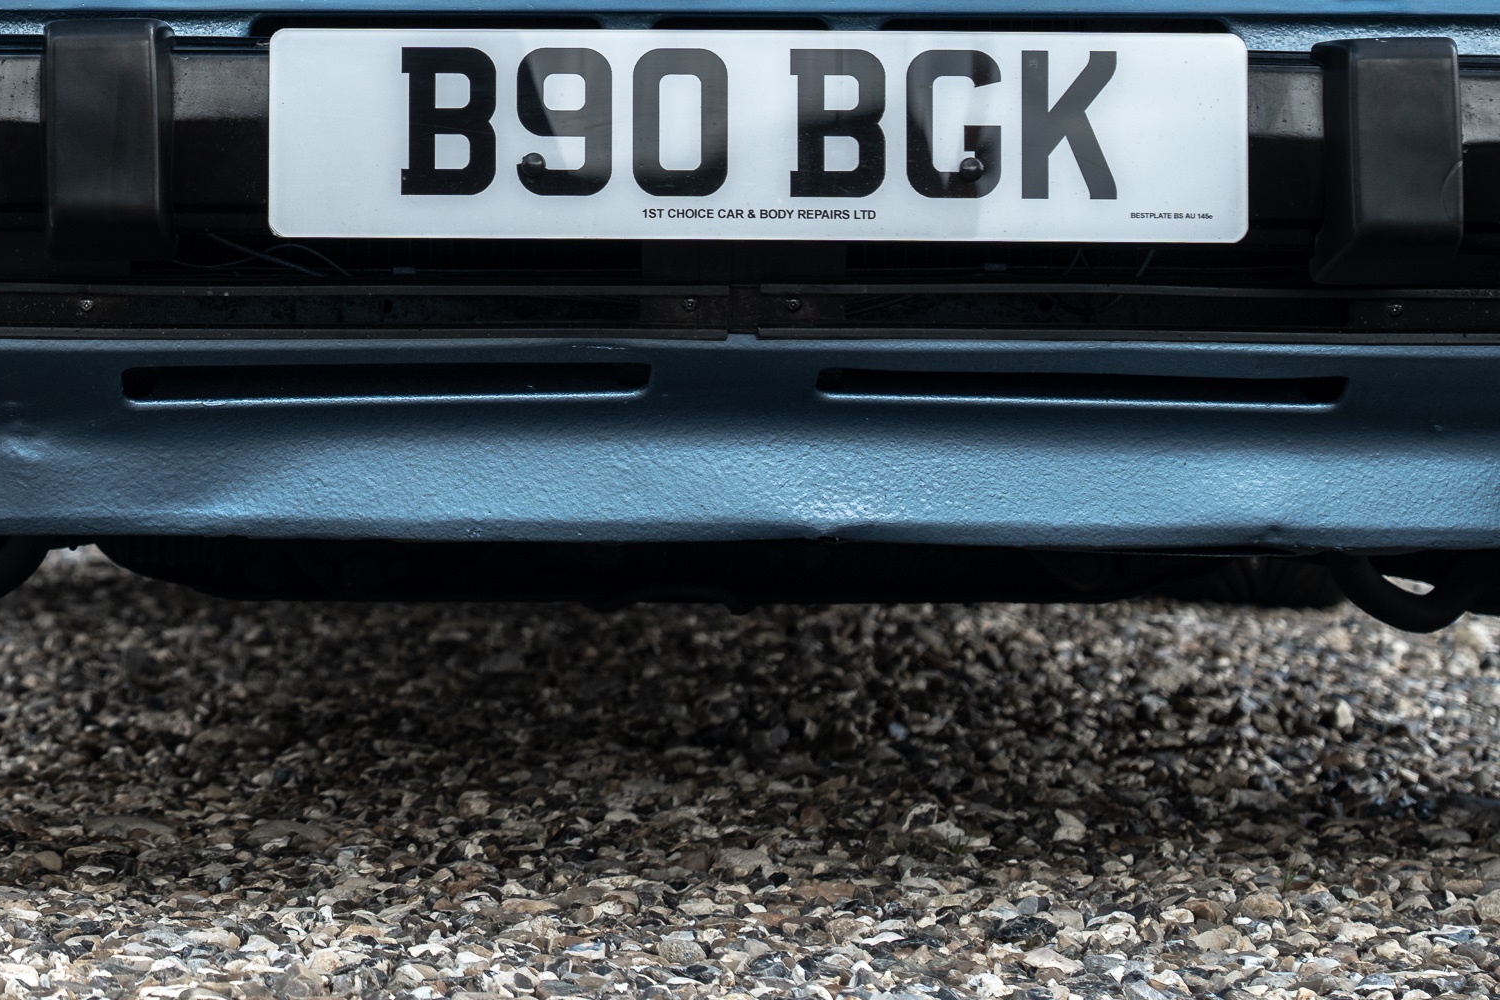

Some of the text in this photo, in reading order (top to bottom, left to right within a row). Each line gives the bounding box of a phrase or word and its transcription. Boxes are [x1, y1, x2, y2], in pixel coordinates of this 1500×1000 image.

[401, 47, 1118, 199] B90 BGK
[642, 208, 877, 220] 1ST CHOICE CAR & BODY REPAIRS LTD
[1130, 212, 1173, 220] BESTPLATE
[1173, 212, 1184, 220] BS
[1185, 212, 1196, 220] AU
